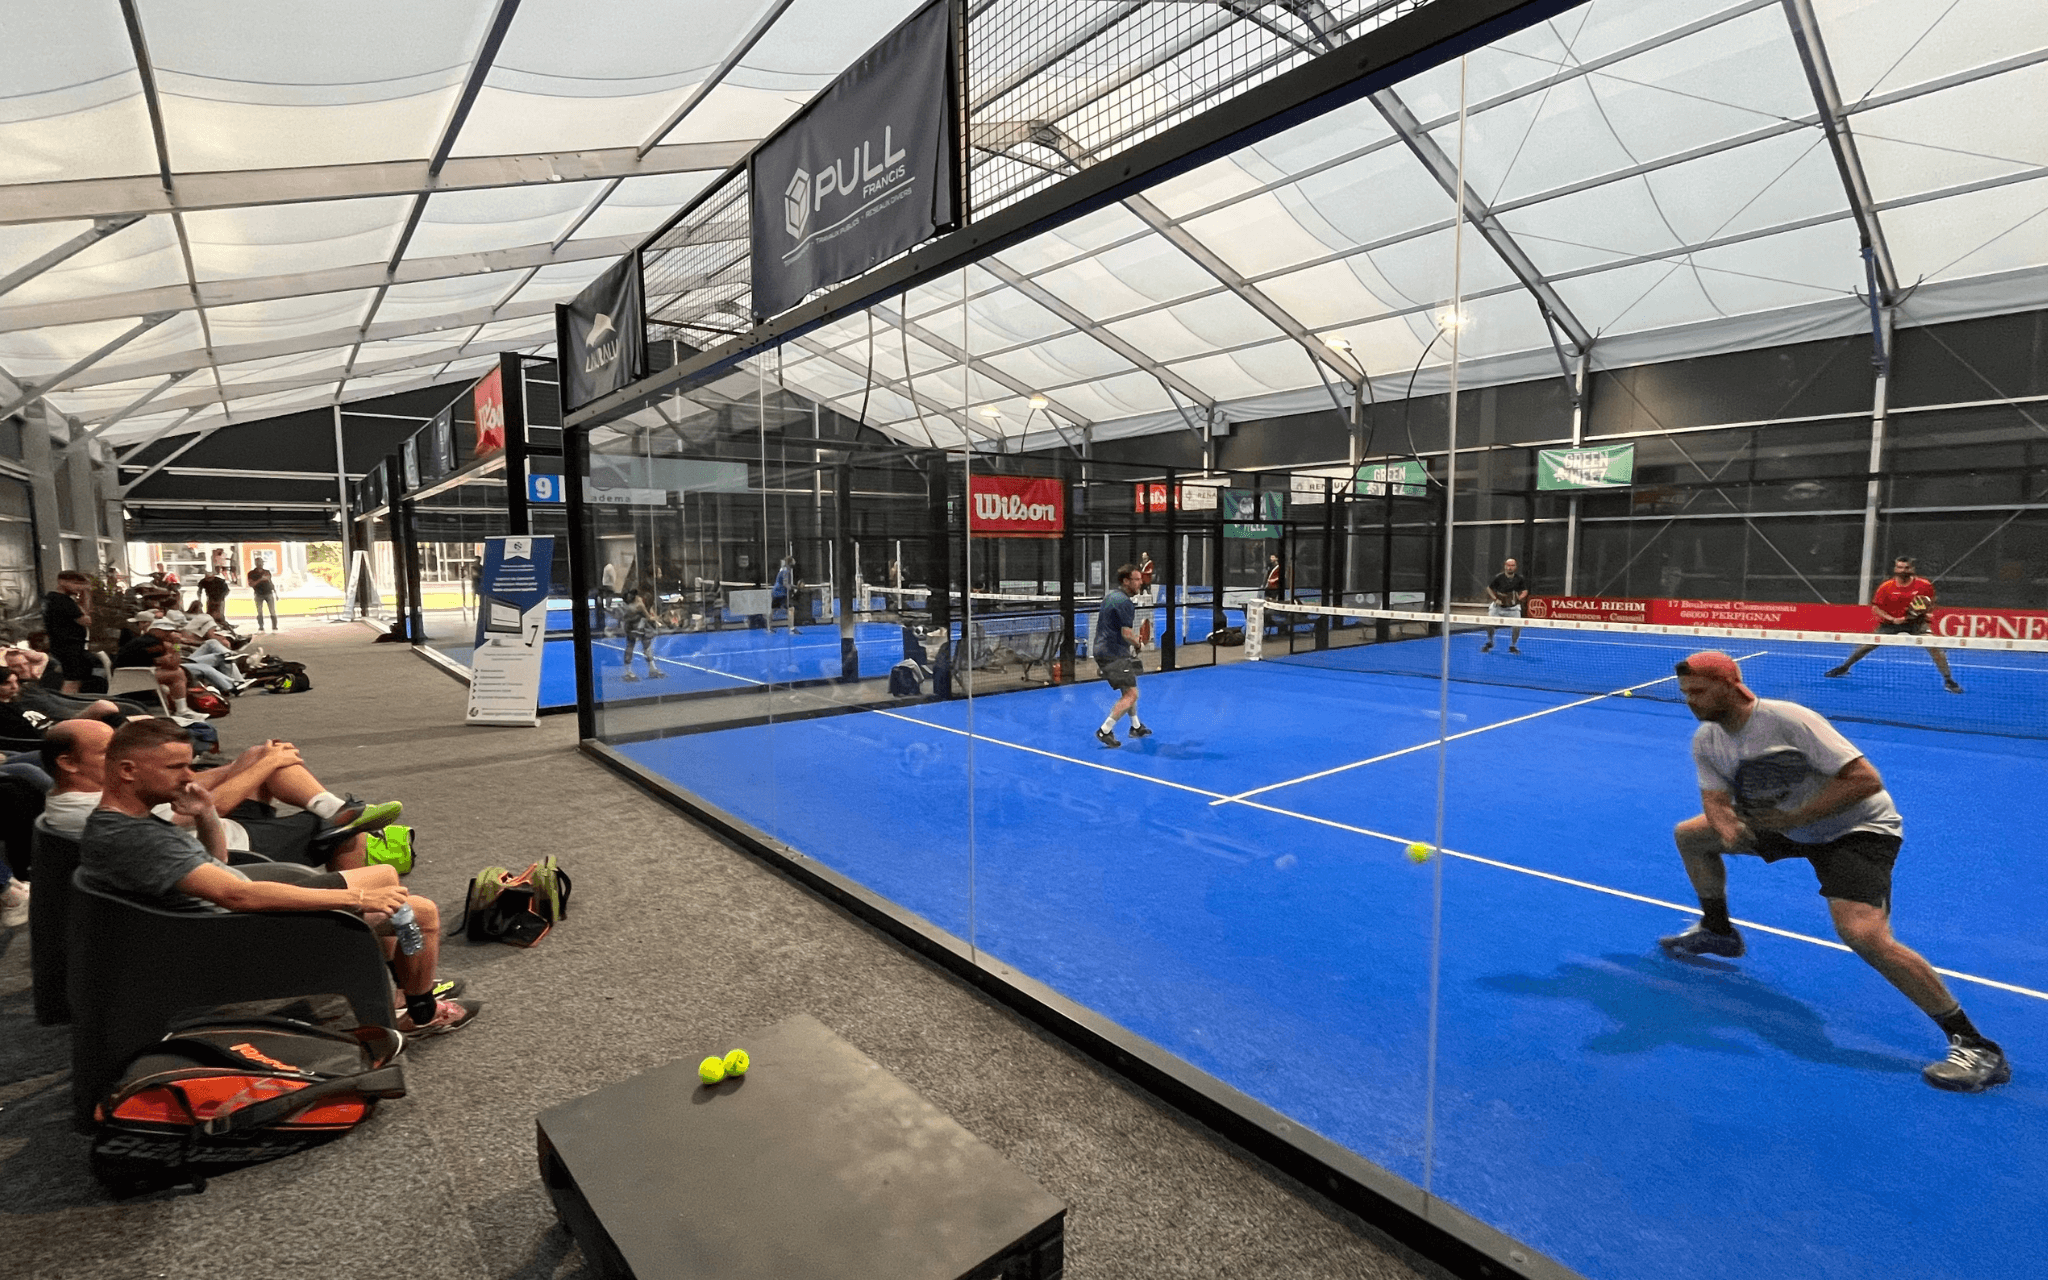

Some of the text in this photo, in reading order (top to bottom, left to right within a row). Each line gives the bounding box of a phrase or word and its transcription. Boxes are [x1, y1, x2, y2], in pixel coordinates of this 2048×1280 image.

[815, 125, 906, 212] PULL
[863, 164, 906, 199] FRANCIS
[535, 476, 553, 500] 9
[1309, 481, 1349, 491] RENUL
[973, 493, 1056, 521] Wilson
[1551, 600, 1646, 612] PASCAL RIEHM
[1668, 600, 1679, 608] 17
[1712, 611, 1781, 622] PERPIGNAN
